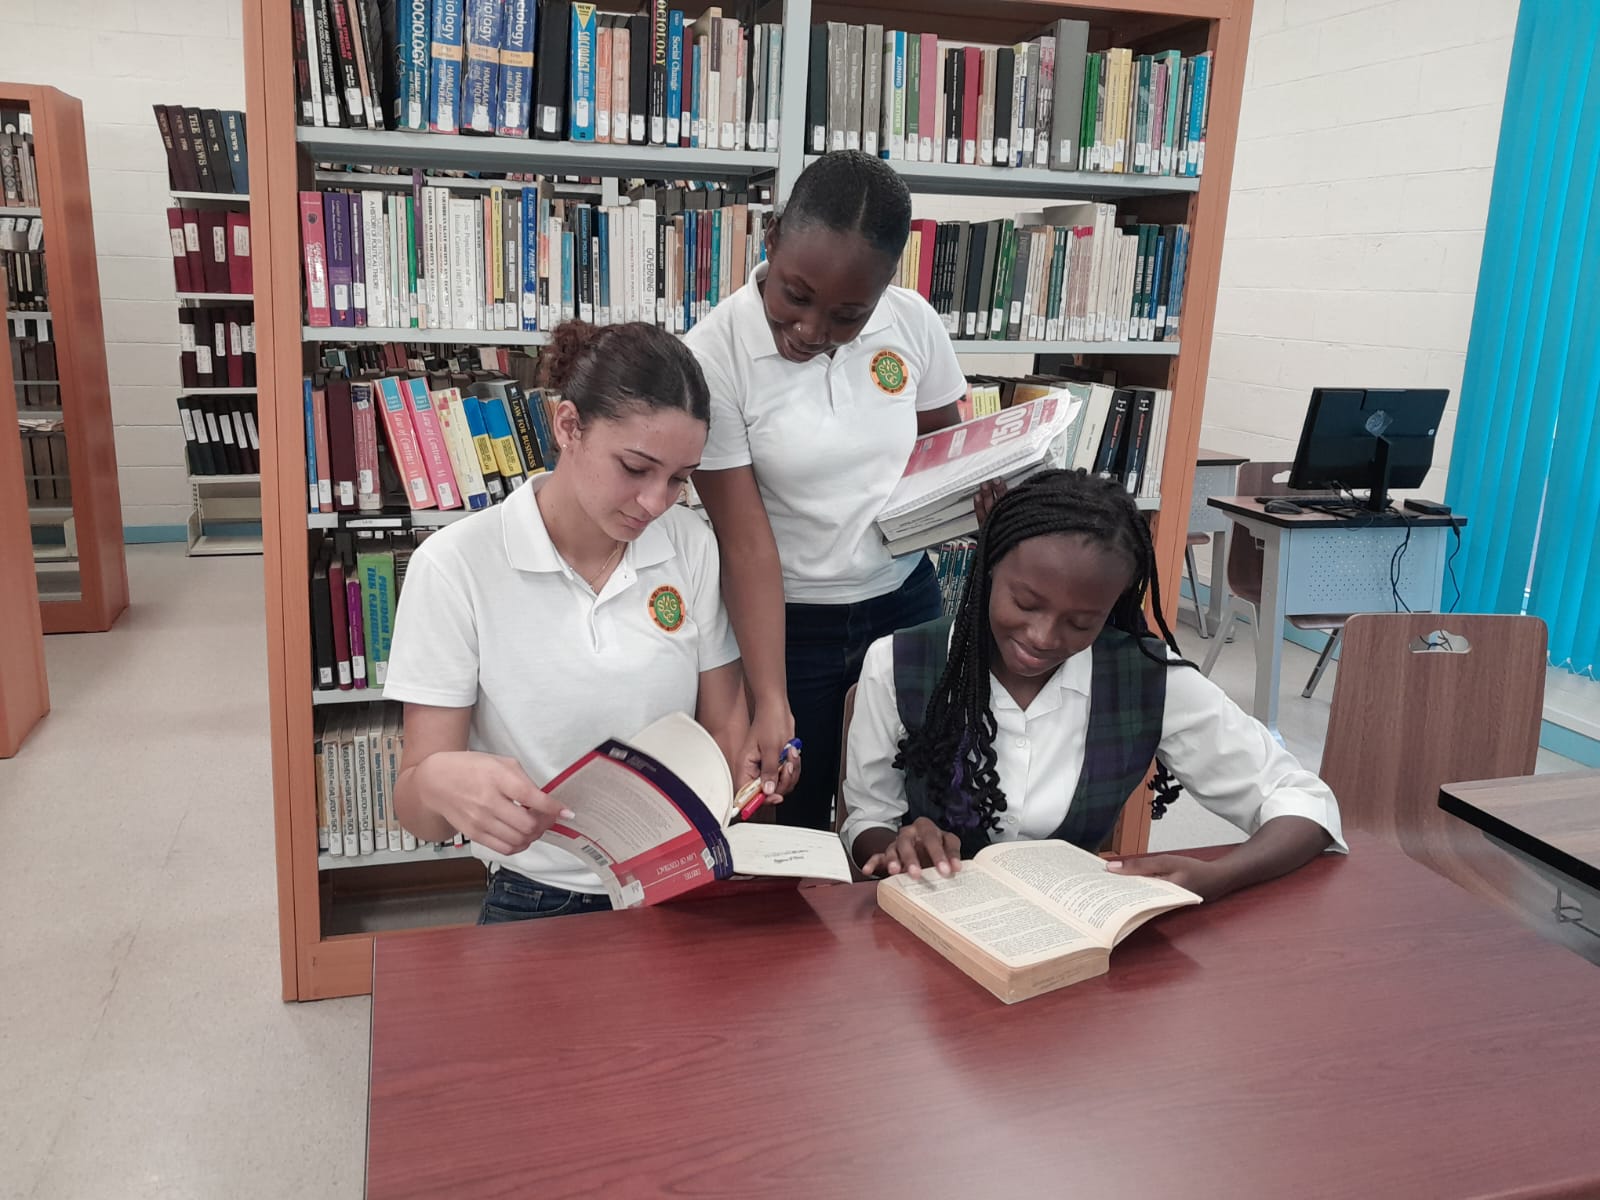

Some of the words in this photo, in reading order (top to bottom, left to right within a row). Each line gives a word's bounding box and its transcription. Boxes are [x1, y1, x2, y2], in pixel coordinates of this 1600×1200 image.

[441, 0, 458, 40] iology
[479, 0, 496, 41] iology
[511, 0, 527, 47] ciology
[655, 0, 667, 66] OCIOLOGY
[577, 31, 590, 73] SOCIOLOGY
[671, 36, 681, 60] Social
[671, 61, 681, 91] Change
[188, 114, 201, 134] THE
[207, 119, 217, 138] NEWS
[228, 115, 236, 130] THE
[193, 138, 208, 166] NEWS
[230, 130, 239, 151] NEWS
[527, 193, 535, 219] ALCOHOL
[646, 247, 654, 292] GOVERNING
[511, 399, 522, 417] LAW
[393, 412, 404, 428] Law
[400, 437, 415, 465] Contract
[422, 412, 432, 428] Law
[428, 437, 443, 465] Contract
[516, 419, 526, 434] FOR
[990, 408, 1027, 445] 150
[521, 435, 536, 469] BUSINESS
[367, 566, 378, 589] THE
[378, 575, 391, 634] FREEDOM
[357, 741, 367, 777] MEASUREMENT
[328, 785, 336, 814] EVALUATION
[345, 786, 353, 813] EVALUATION
[360, 783, 368, 812] EVALUATION
